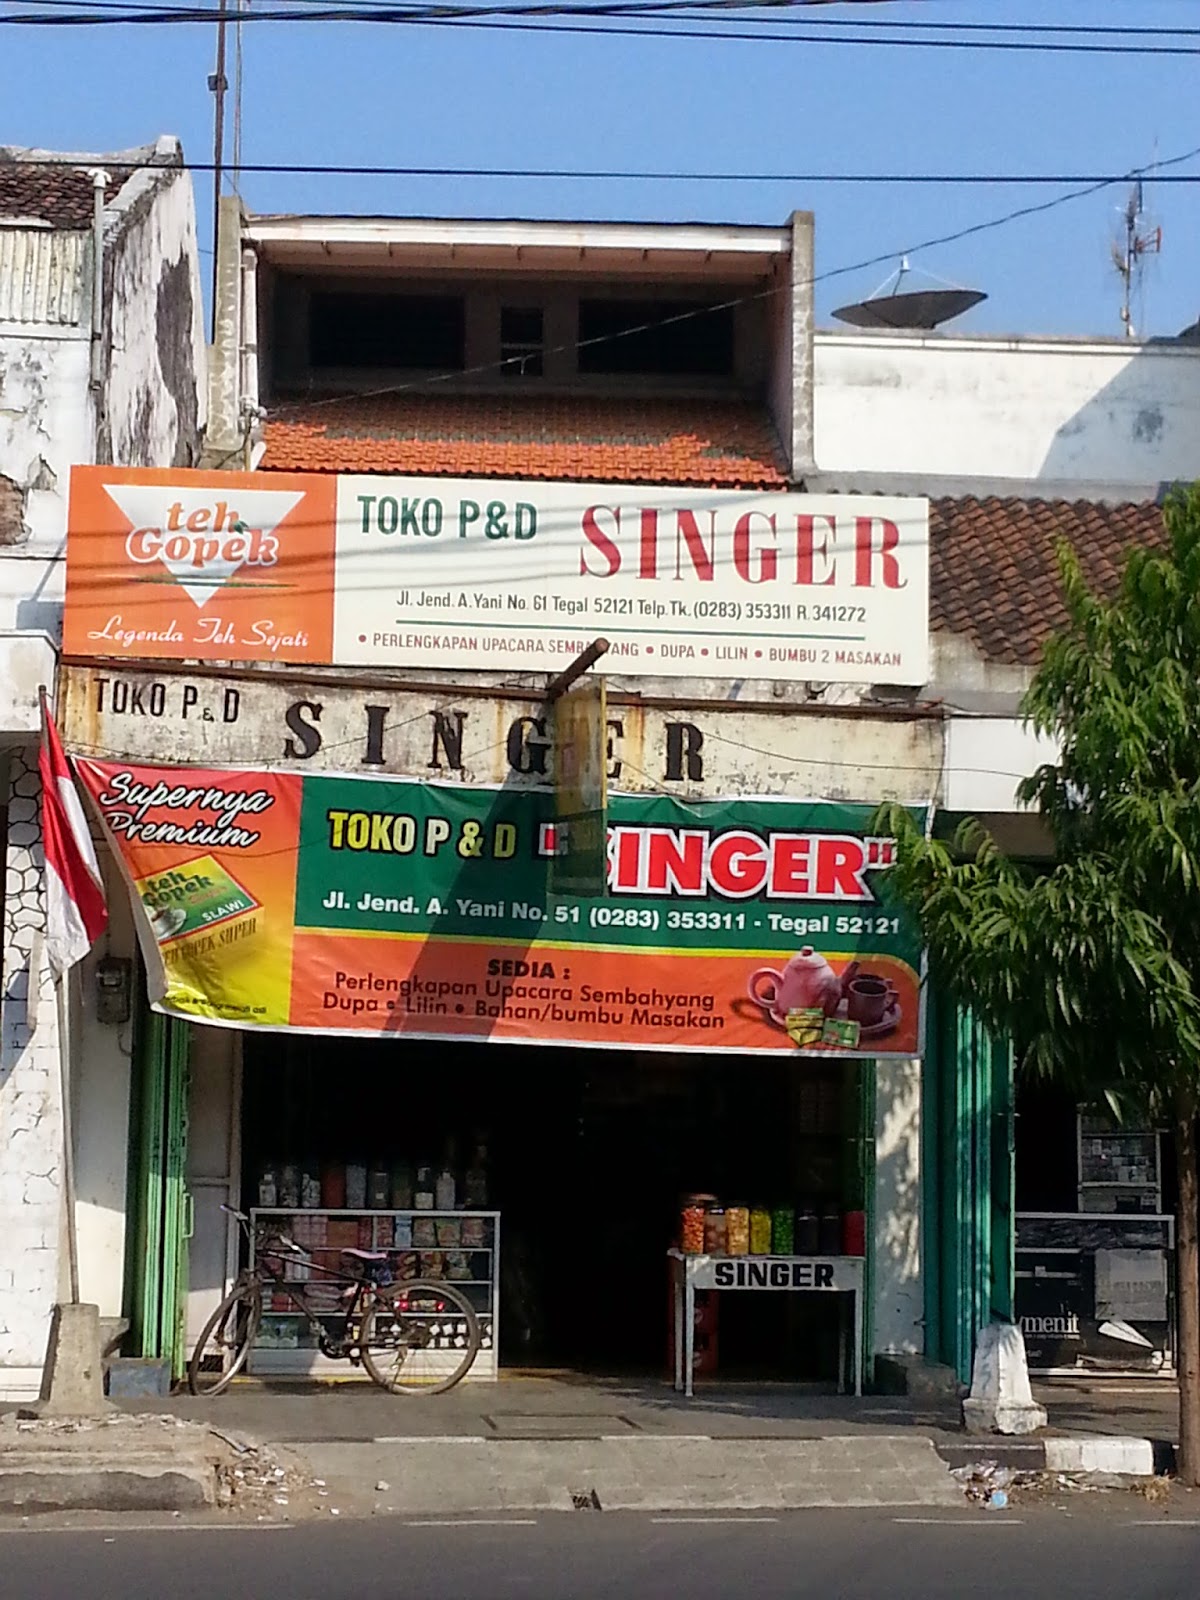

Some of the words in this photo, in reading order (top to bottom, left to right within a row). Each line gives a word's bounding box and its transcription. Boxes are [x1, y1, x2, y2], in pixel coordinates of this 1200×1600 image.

[167, 501, 239, 533] teh
[357, 495, 443, 537] TOKO
[459, 500, 538, 541] P&D
[125, 526, 280, 568] Gopek
[579, 504, 908, 589] SINGER
[396, 590, 414, 606] Jl.
[416, 591, 455, 608] Jend.
[507, 594, 530, 611] No.
[552, 595, 588, 615] Tegal
[593, 597, 634, 615] 52121
[745, 602, 792, 620] 353311
[87, 614, 185, 647] Legenda
[193, 618, 236, 645] Teh
[241, 620, 309, 652] Sejati
[372, 632, 478, 651] PERLENGKAPAN
[482, 638, 545, 653] UPACARA
[660, 644, 696, 658] DUPA
[715, 646, 748, 660] LILIN
[769, 647, 817, 663] BUMBU
[821, 650, 830, 663] 2
[835, 650, 902, 667] MASAKAN
[94, 678, 165, 717] TOKO
[100, 772, 274, 828] Supernya
[108, 811, 259, 847] Premium
[327, 811, 415, 853] TOKO
[147, 871, 188, 894] teh
[202, 899, 245, 922] SLAWI
[323, 891, 350, 909] Jl.
[357, 894, 419, 914] Jend.
[426, 898, 448, 915] A.
[456, 900, 504, 918] Yani
[511, 902, 548, 922] No.
[554, 906, 580, 923] 51
[589, 907, 660, 931] (0283)
[666, 911, 746, 931] 353311
[767, 913, 829, 936] Tegal
[835, 917, 900, 935] 52121
[487, 959, 555, 979] SEDIA
[335, 972, 477, 996] Perlengkapan
[485, 980, 573, 1001] Upacara
[580, 985, 714, 1011] Sembahyang
[323, 992, 378, 1014] Dupa
[406, 997, 447, 1014] Lilin
[475, 1001, 624, 1024] Bahan/bumbu
[630, 1010, 724, 1029] Masakan
[714, 1262, 834, 1287] SINGER
